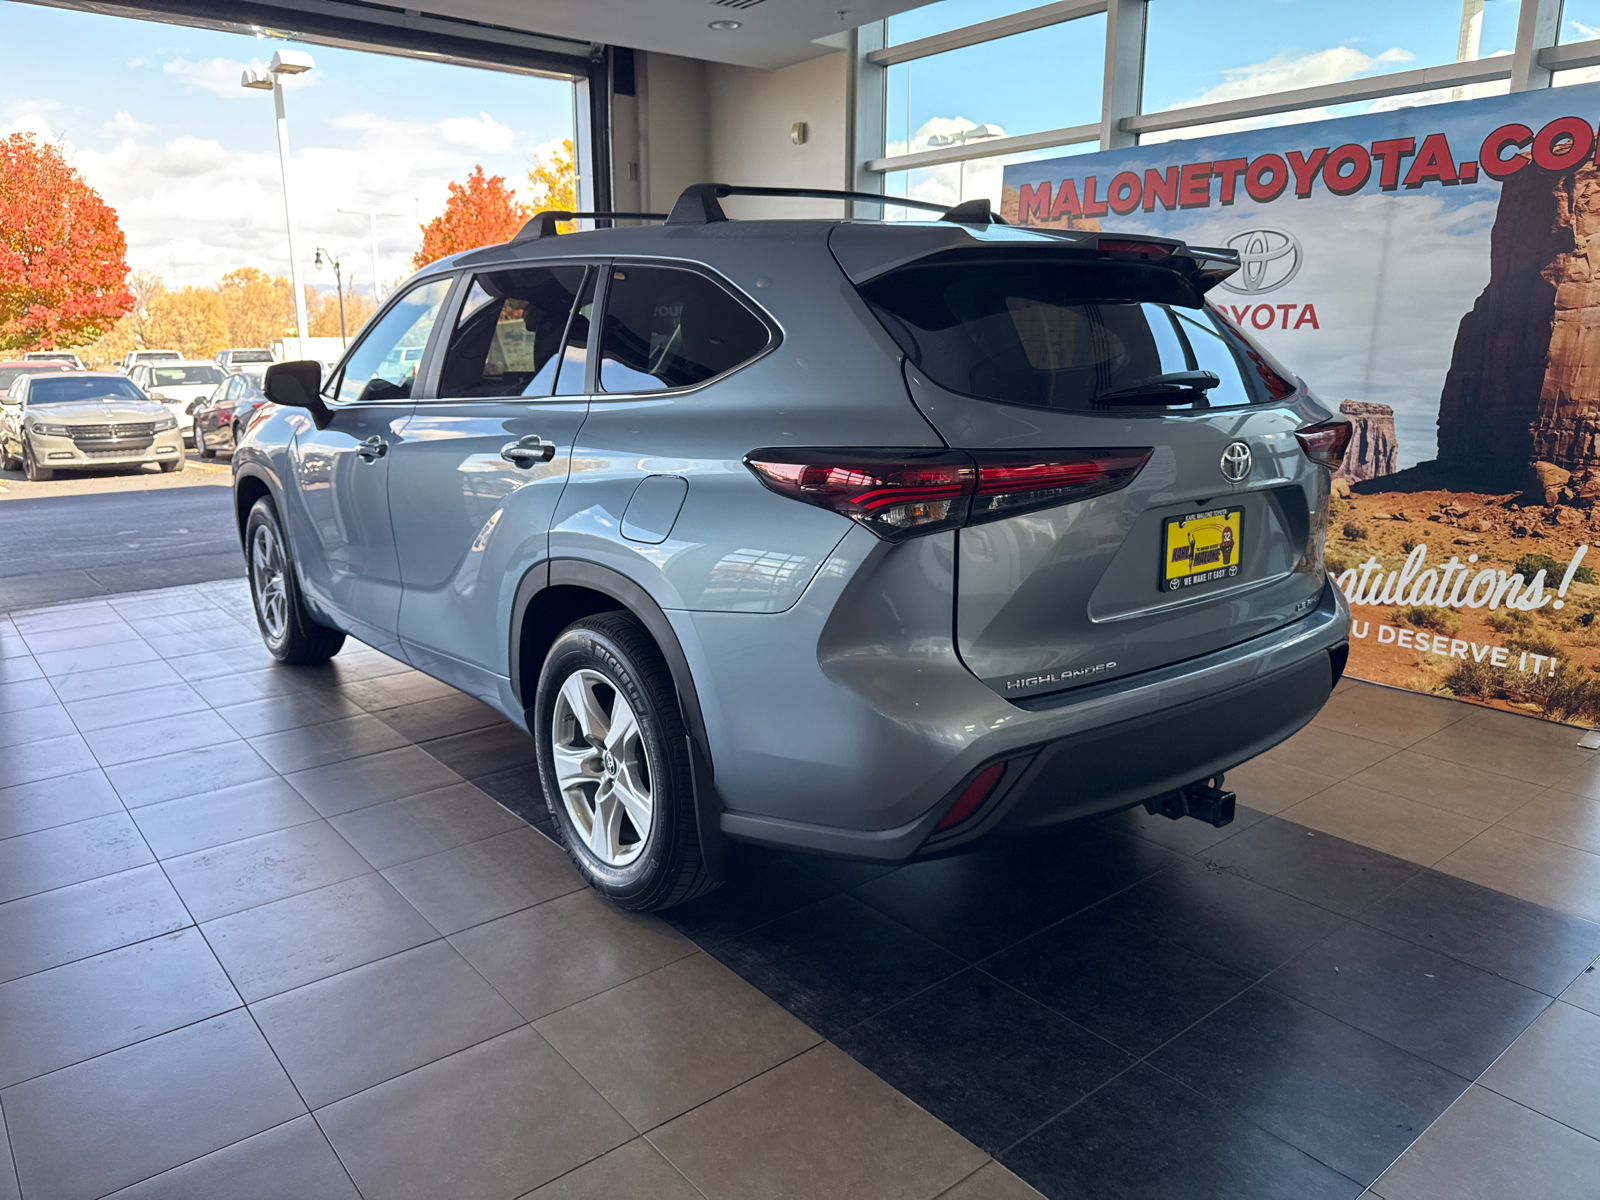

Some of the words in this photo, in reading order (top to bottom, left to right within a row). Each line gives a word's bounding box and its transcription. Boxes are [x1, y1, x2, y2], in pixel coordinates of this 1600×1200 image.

[1017, 115, 1600, 223] MALONETOYOTA.CO
[1216, 303, 1320, 330] YOTA
[1223, 531, 1231, 542] 32
[1184, 578, 1192, 586] WE
[1193, 574, 1206, 584] MAKE
[1207, 572, 1212, 580] IT
[1213, 569, 1225, 578] EASY
[1329, 543, 1588, 611] atulations!
[1377, 624, 1510, 668] DESERVE
[1518, 651, 1557, 677] IT!
[594, 645, 646, 713] MICHELIN
[1006, 661, 1117, 690] HIGHLANDER
